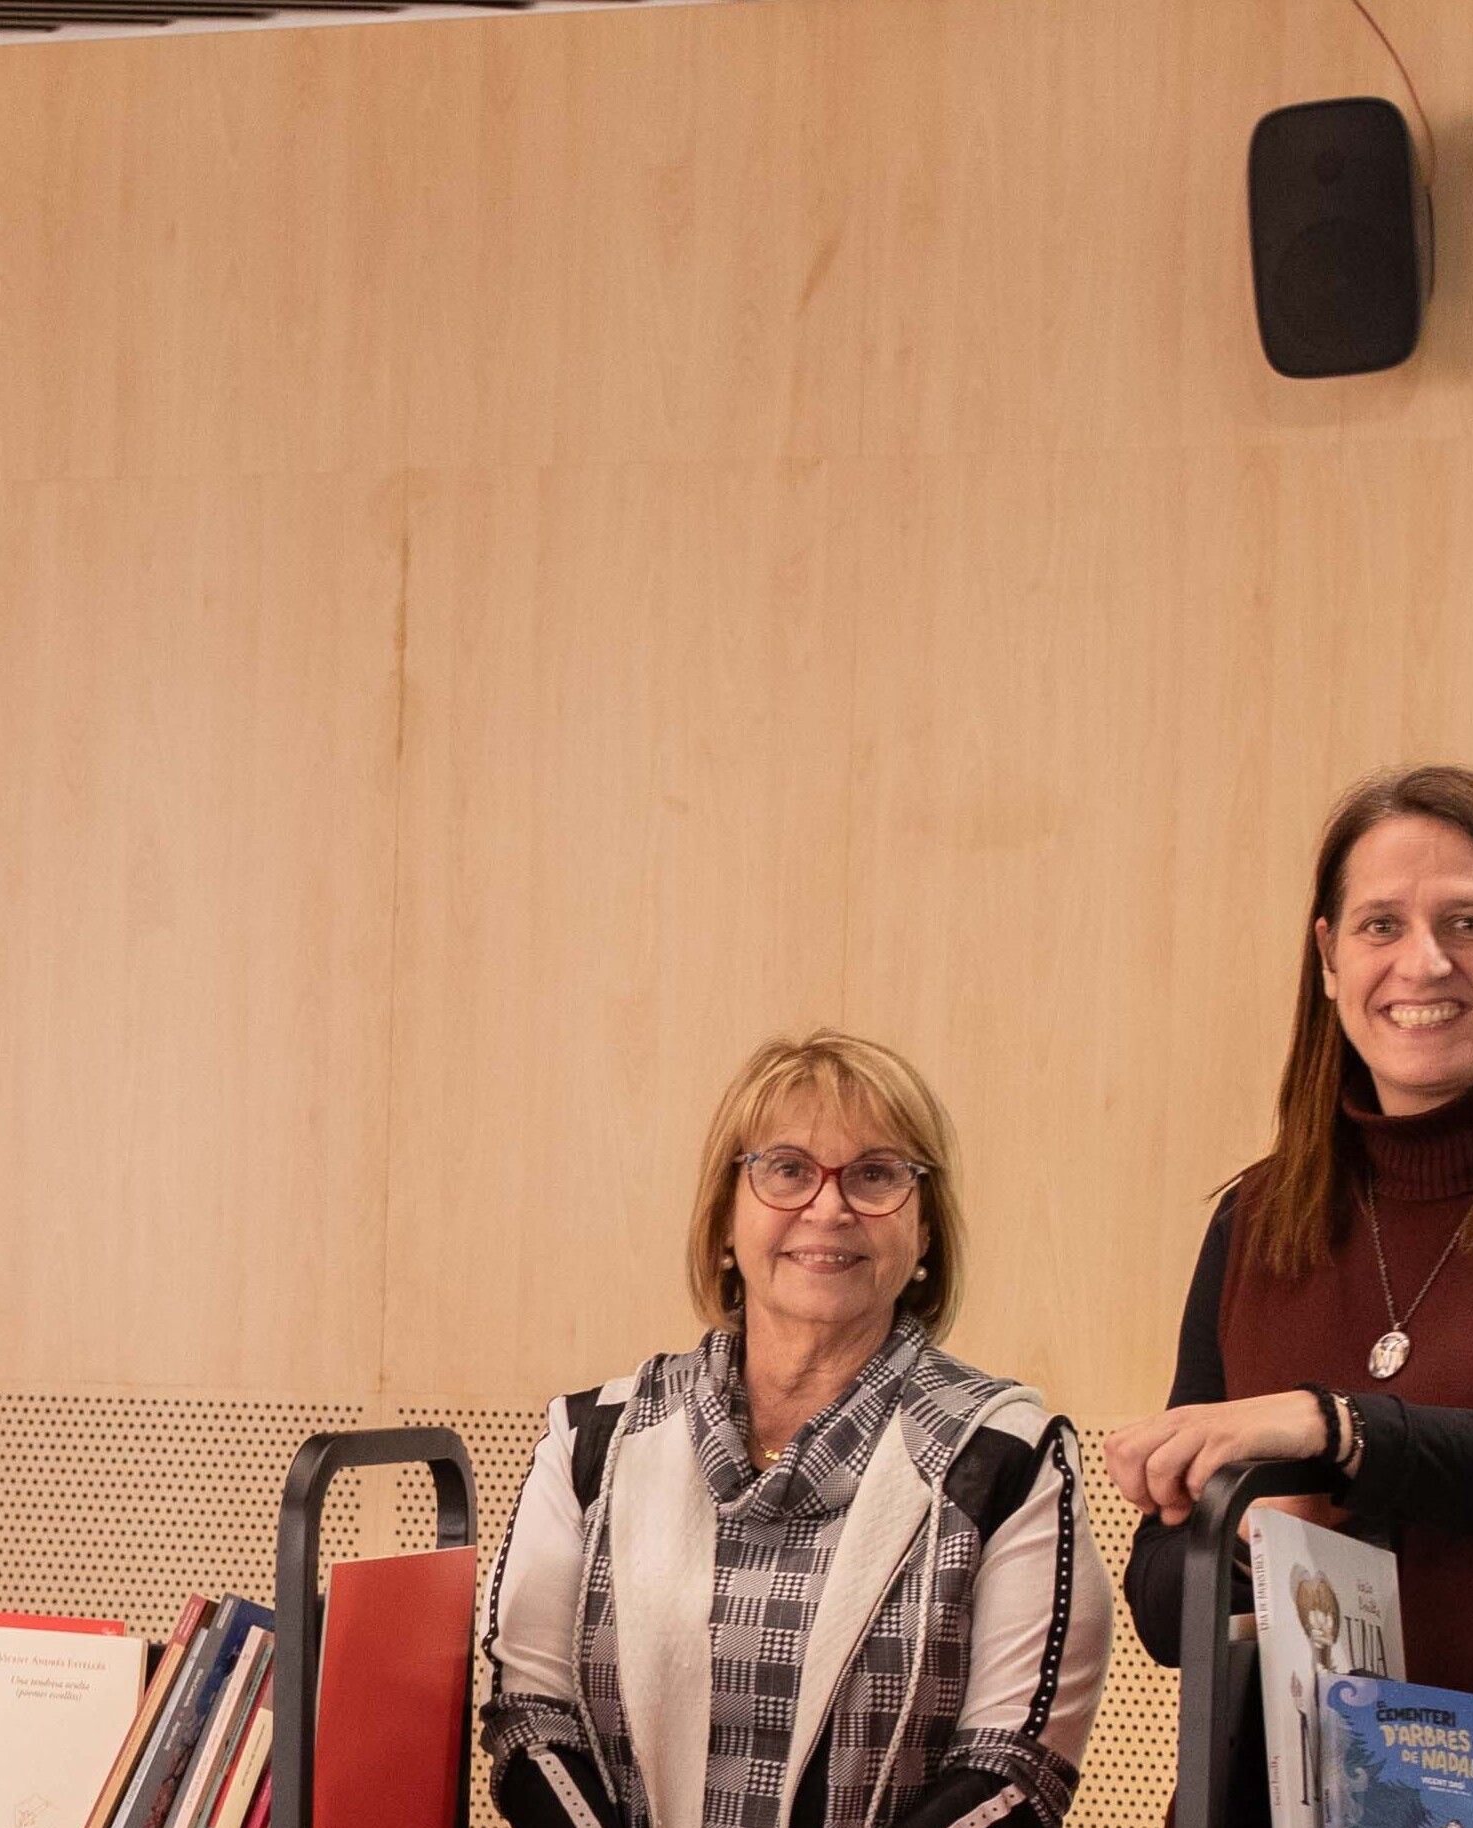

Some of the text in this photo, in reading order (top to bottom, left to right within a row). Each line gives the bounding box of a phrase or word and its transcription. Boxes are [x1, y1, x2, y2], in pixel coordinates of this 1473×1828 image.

[1377, 1708, 1456, 1727] CEMENTERI
[1379, 1724, 1472, 1752] D'ARBRES
[1401, 1749, 1420, 1764] DE
